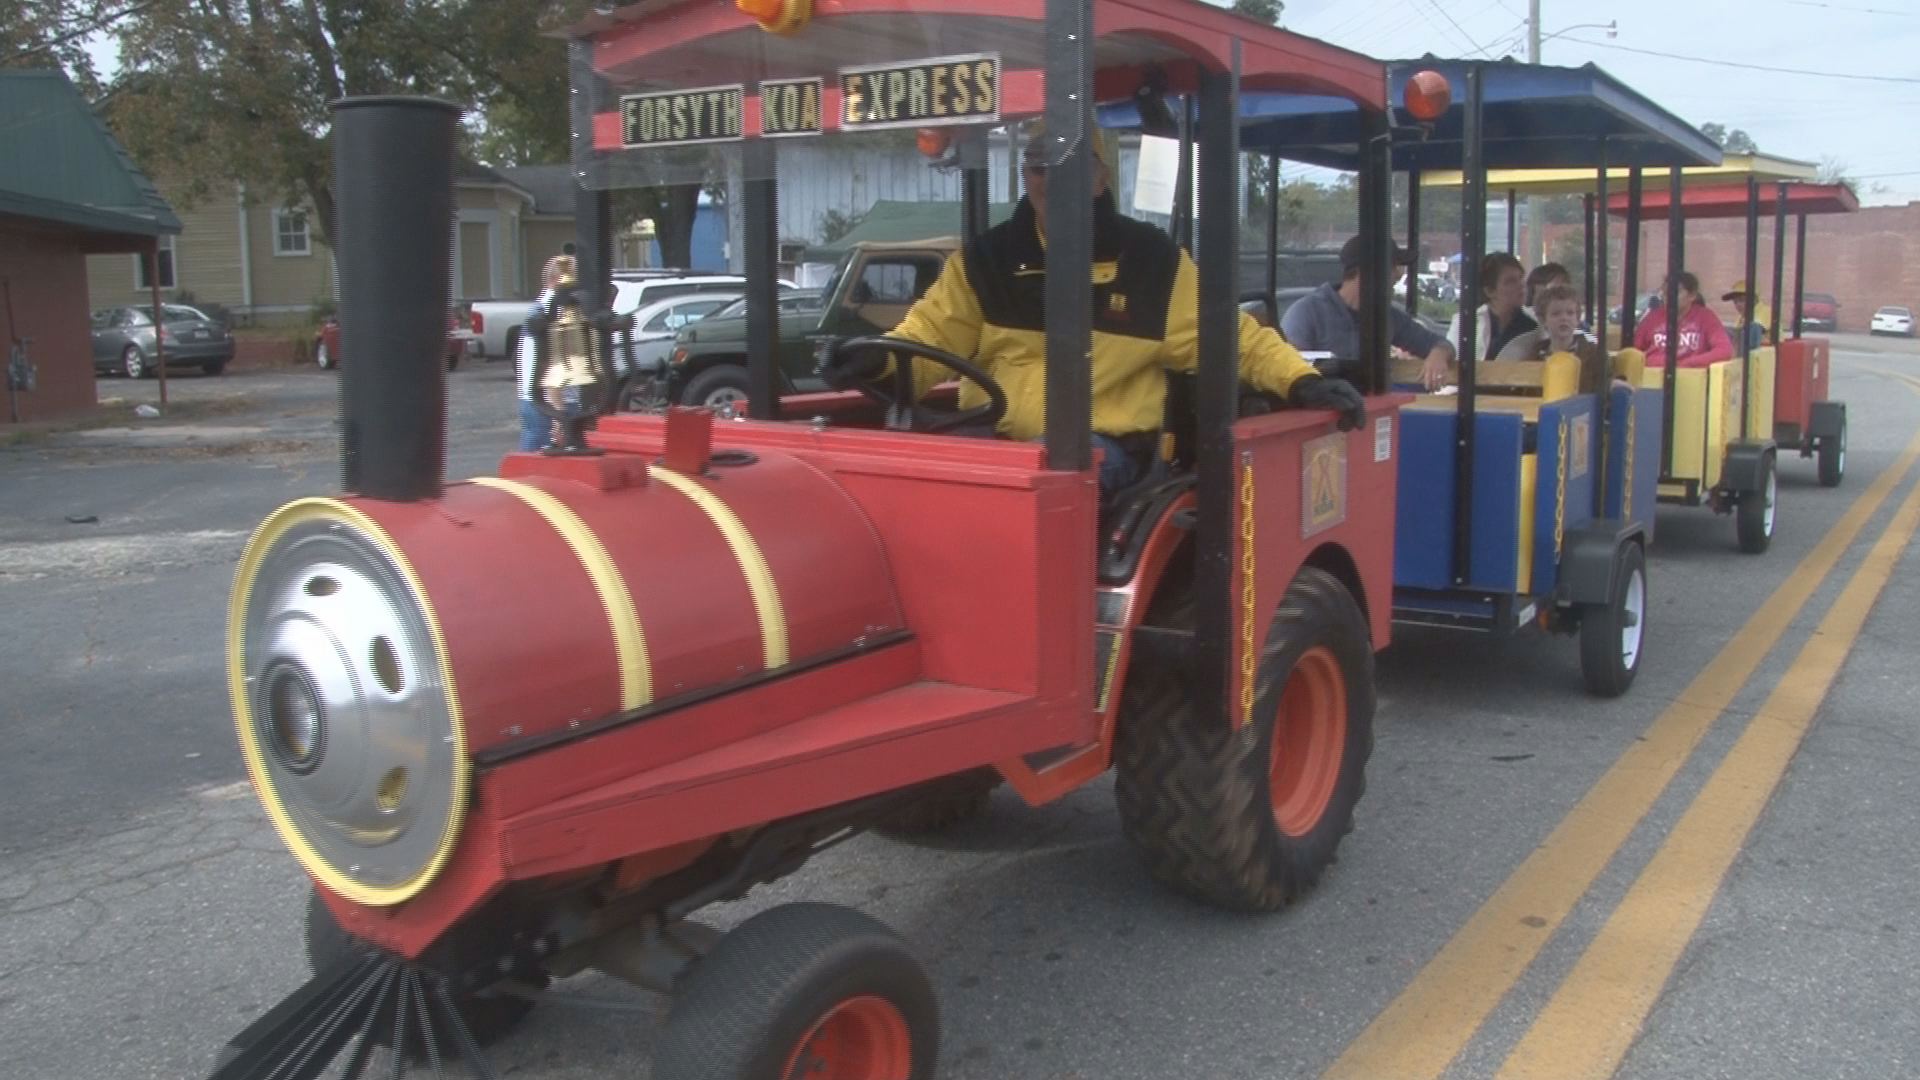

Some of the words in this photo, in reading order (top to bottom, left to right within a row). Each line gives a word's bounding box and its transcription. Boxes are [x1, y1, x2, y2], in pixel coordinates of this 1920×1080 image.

[624, 90, 740, 143] FORSYTH
[764, 81, 816, 131] KOA
[846, 61, 993, 122] EXPRESS
